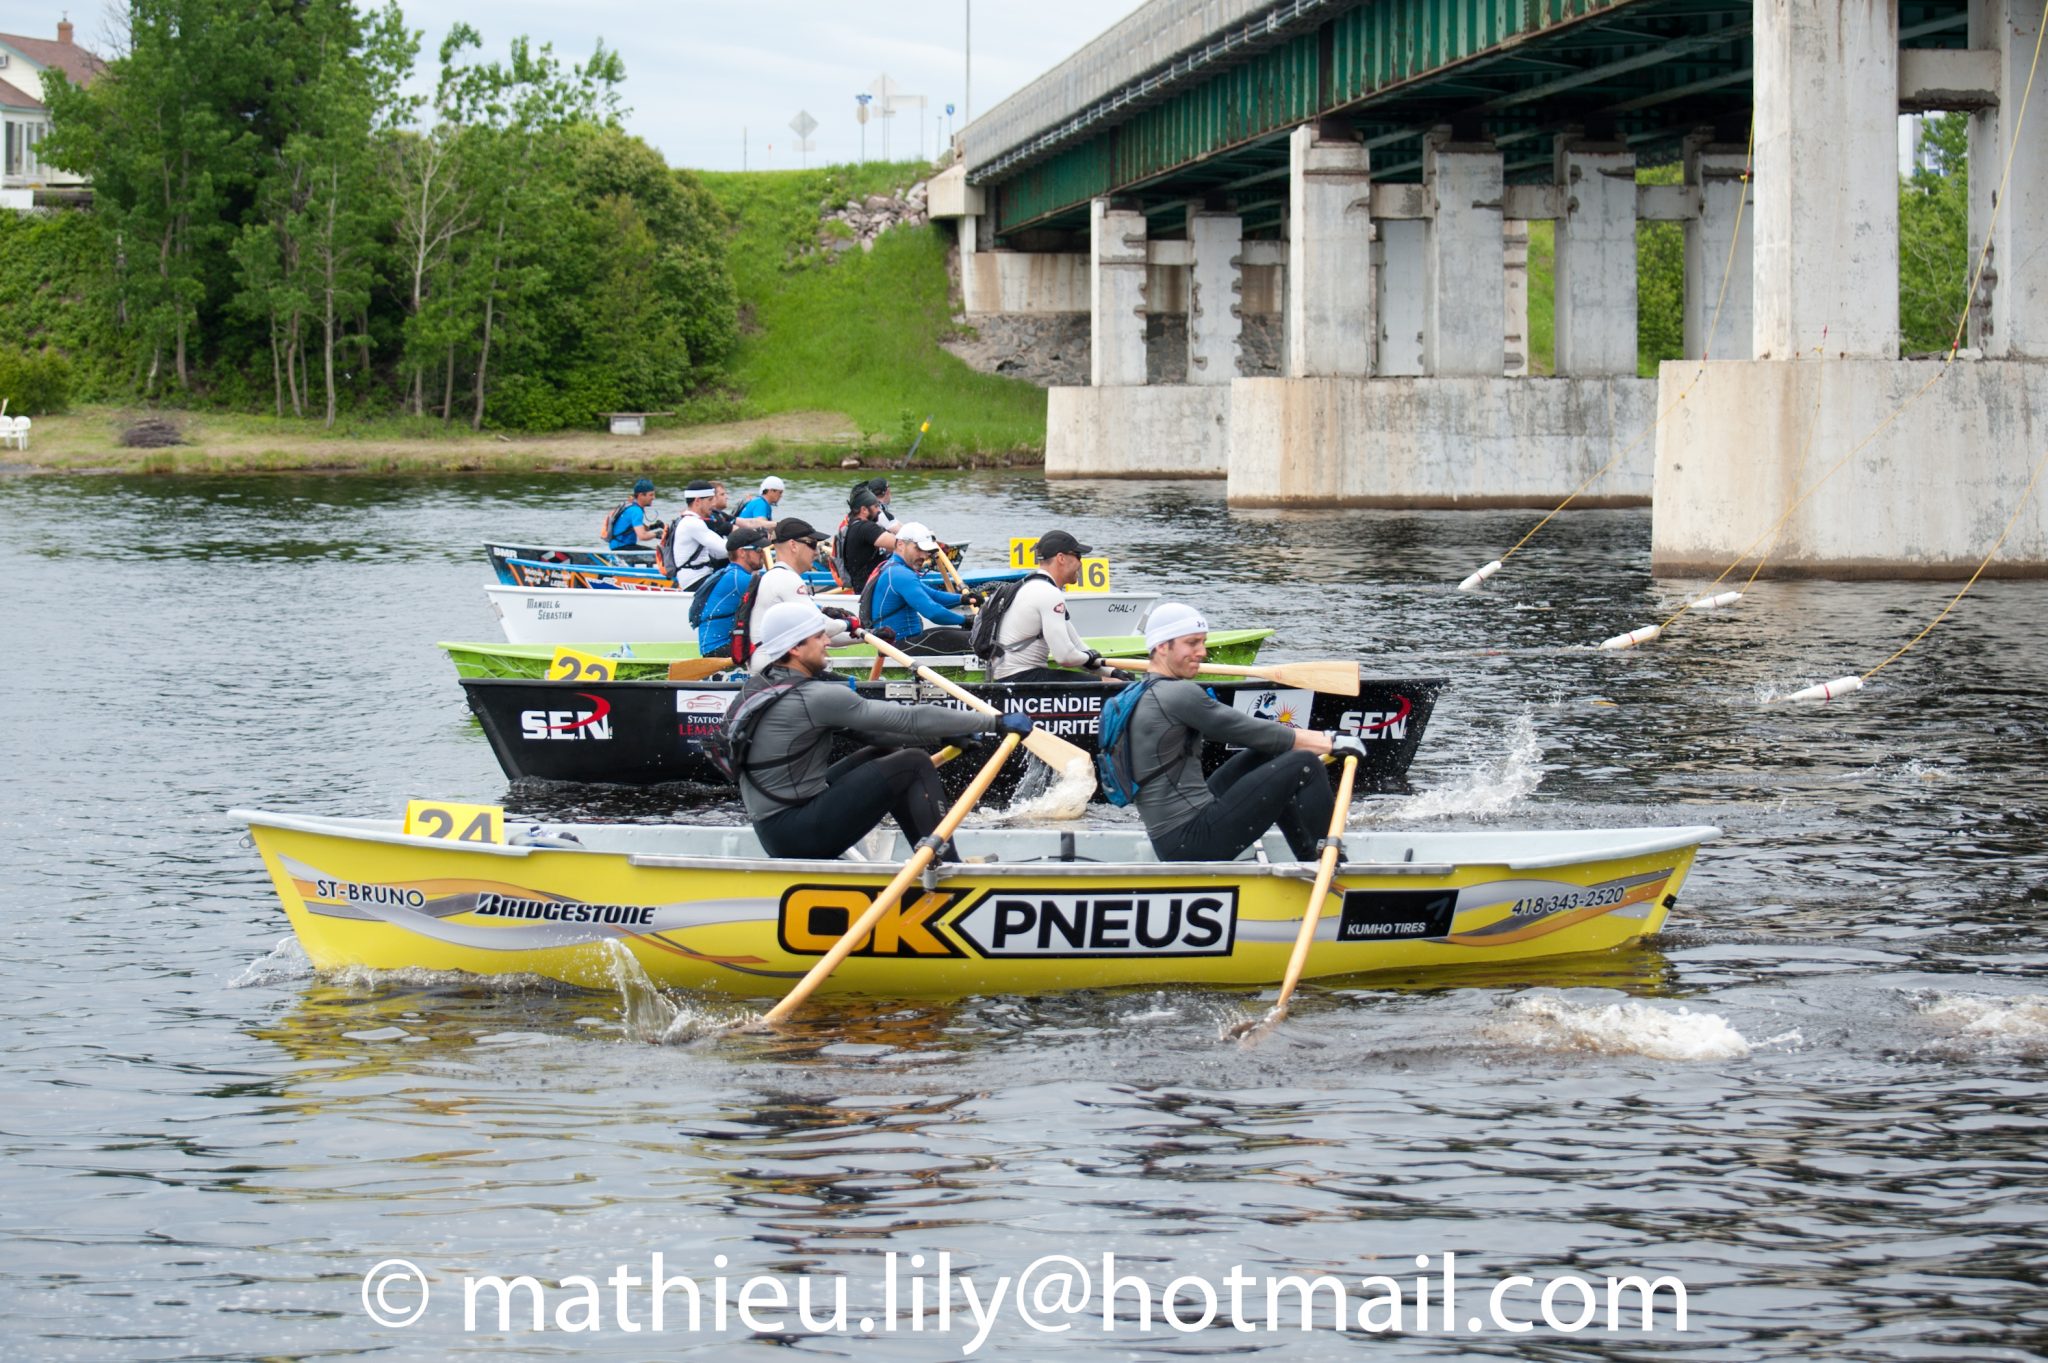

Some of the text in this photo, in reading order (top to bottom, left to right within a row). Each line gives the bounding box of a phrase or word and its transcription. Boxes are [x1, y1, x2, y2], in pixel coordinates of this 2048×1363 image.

[554, 600, 560, 608] &
[1108, 603, 1136, 613] CHAL-1
[1004, 697, 1101, 713] INCENDIE
[418, 808, 497, 844] 24
[317, 879, 424, 907] ST-BRUNO
[1512, 886, 1625, 914] 418 343-2520
[476, 894, 656, 925] BRIDGESTONE
[784, 889, 1225, 955] OK PNEUS
[1346, 922, 1427, 935] KUMHO TIRES
